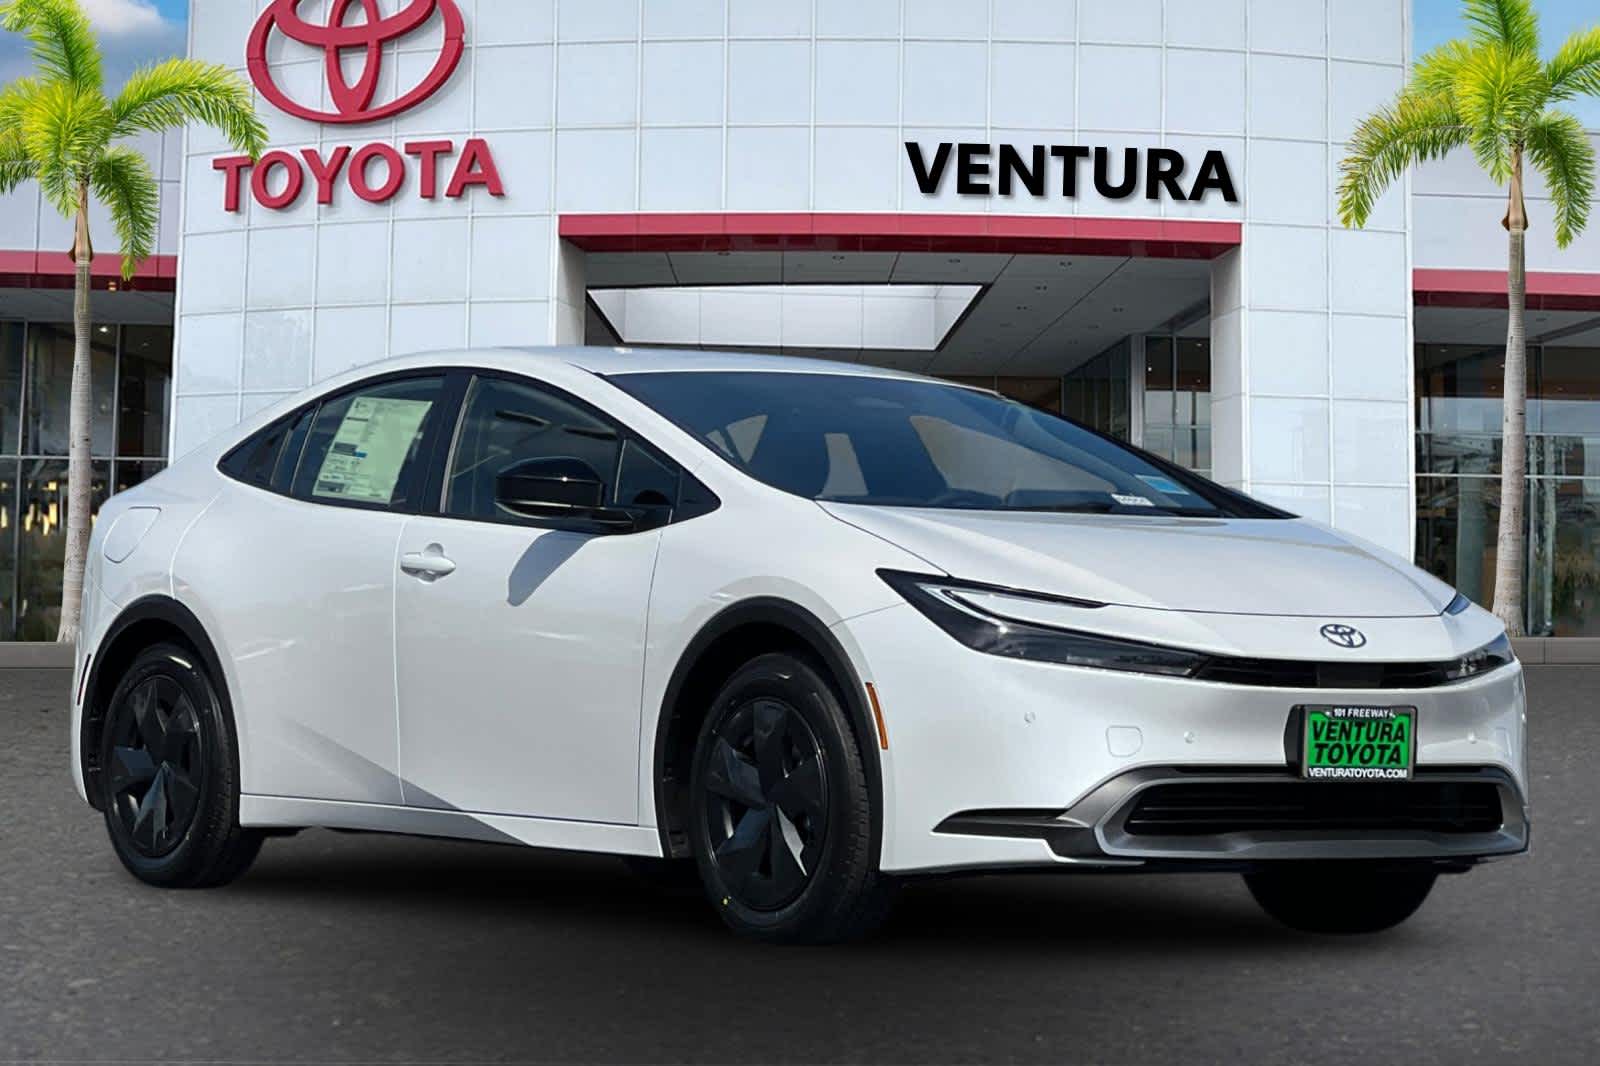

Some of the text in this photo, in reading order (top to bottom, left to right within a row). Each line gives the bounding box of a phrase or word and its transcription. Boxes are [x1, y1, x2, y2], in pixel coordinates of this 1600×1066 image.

[213, 138, 505, 212] TOYOTA
[905, 142, 1238, 202] VENTURA
[1334, 708, 1388, 718] 101 FREEWAY
[1313, 721, 1405, 743] VENTURA
[1314, 743, 1402, 764] TOYOTA
[1308, 767, 1408, 778] VENTURATOYOTA.COM
